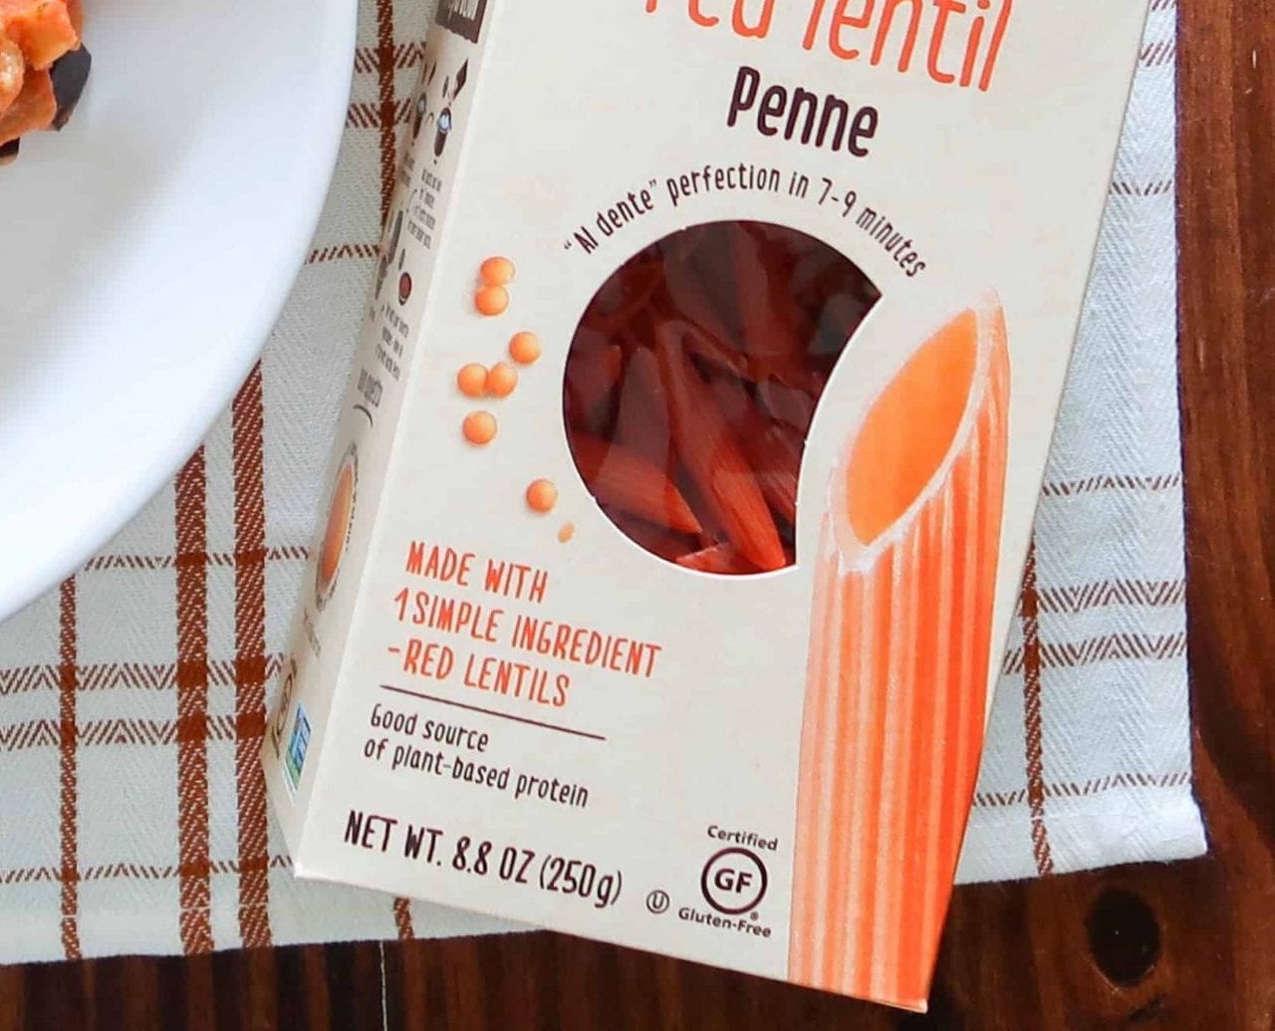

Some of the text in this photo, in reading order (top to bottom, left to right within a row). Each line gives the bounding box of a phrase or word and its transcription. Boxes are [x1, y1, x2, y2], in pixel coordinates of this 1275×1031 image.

[727, 66, 878, 157] Penne
[666, 163, 780, 207] perfection
[789, 172, 809, 198] in
[818, 177, 856, 217] 7-9
[856, 207, 926, 277] minutes
[406, 541, 547, 603] MADE WITH
[512, 615, 661, 677] INGREDIENT
[464, 654, 569, 707] LENTILS
[371, 703, 488, 752] Good source
[364, 738, 588, 808] of plant-based protein
[344, 810, 622, 908] NET WT. 8.8 OZ (250g)
[707, 825, 778, 851] Certified
[714, 869, 753, 896] GF
[679, 907, 771, 937] Gluten-Free
